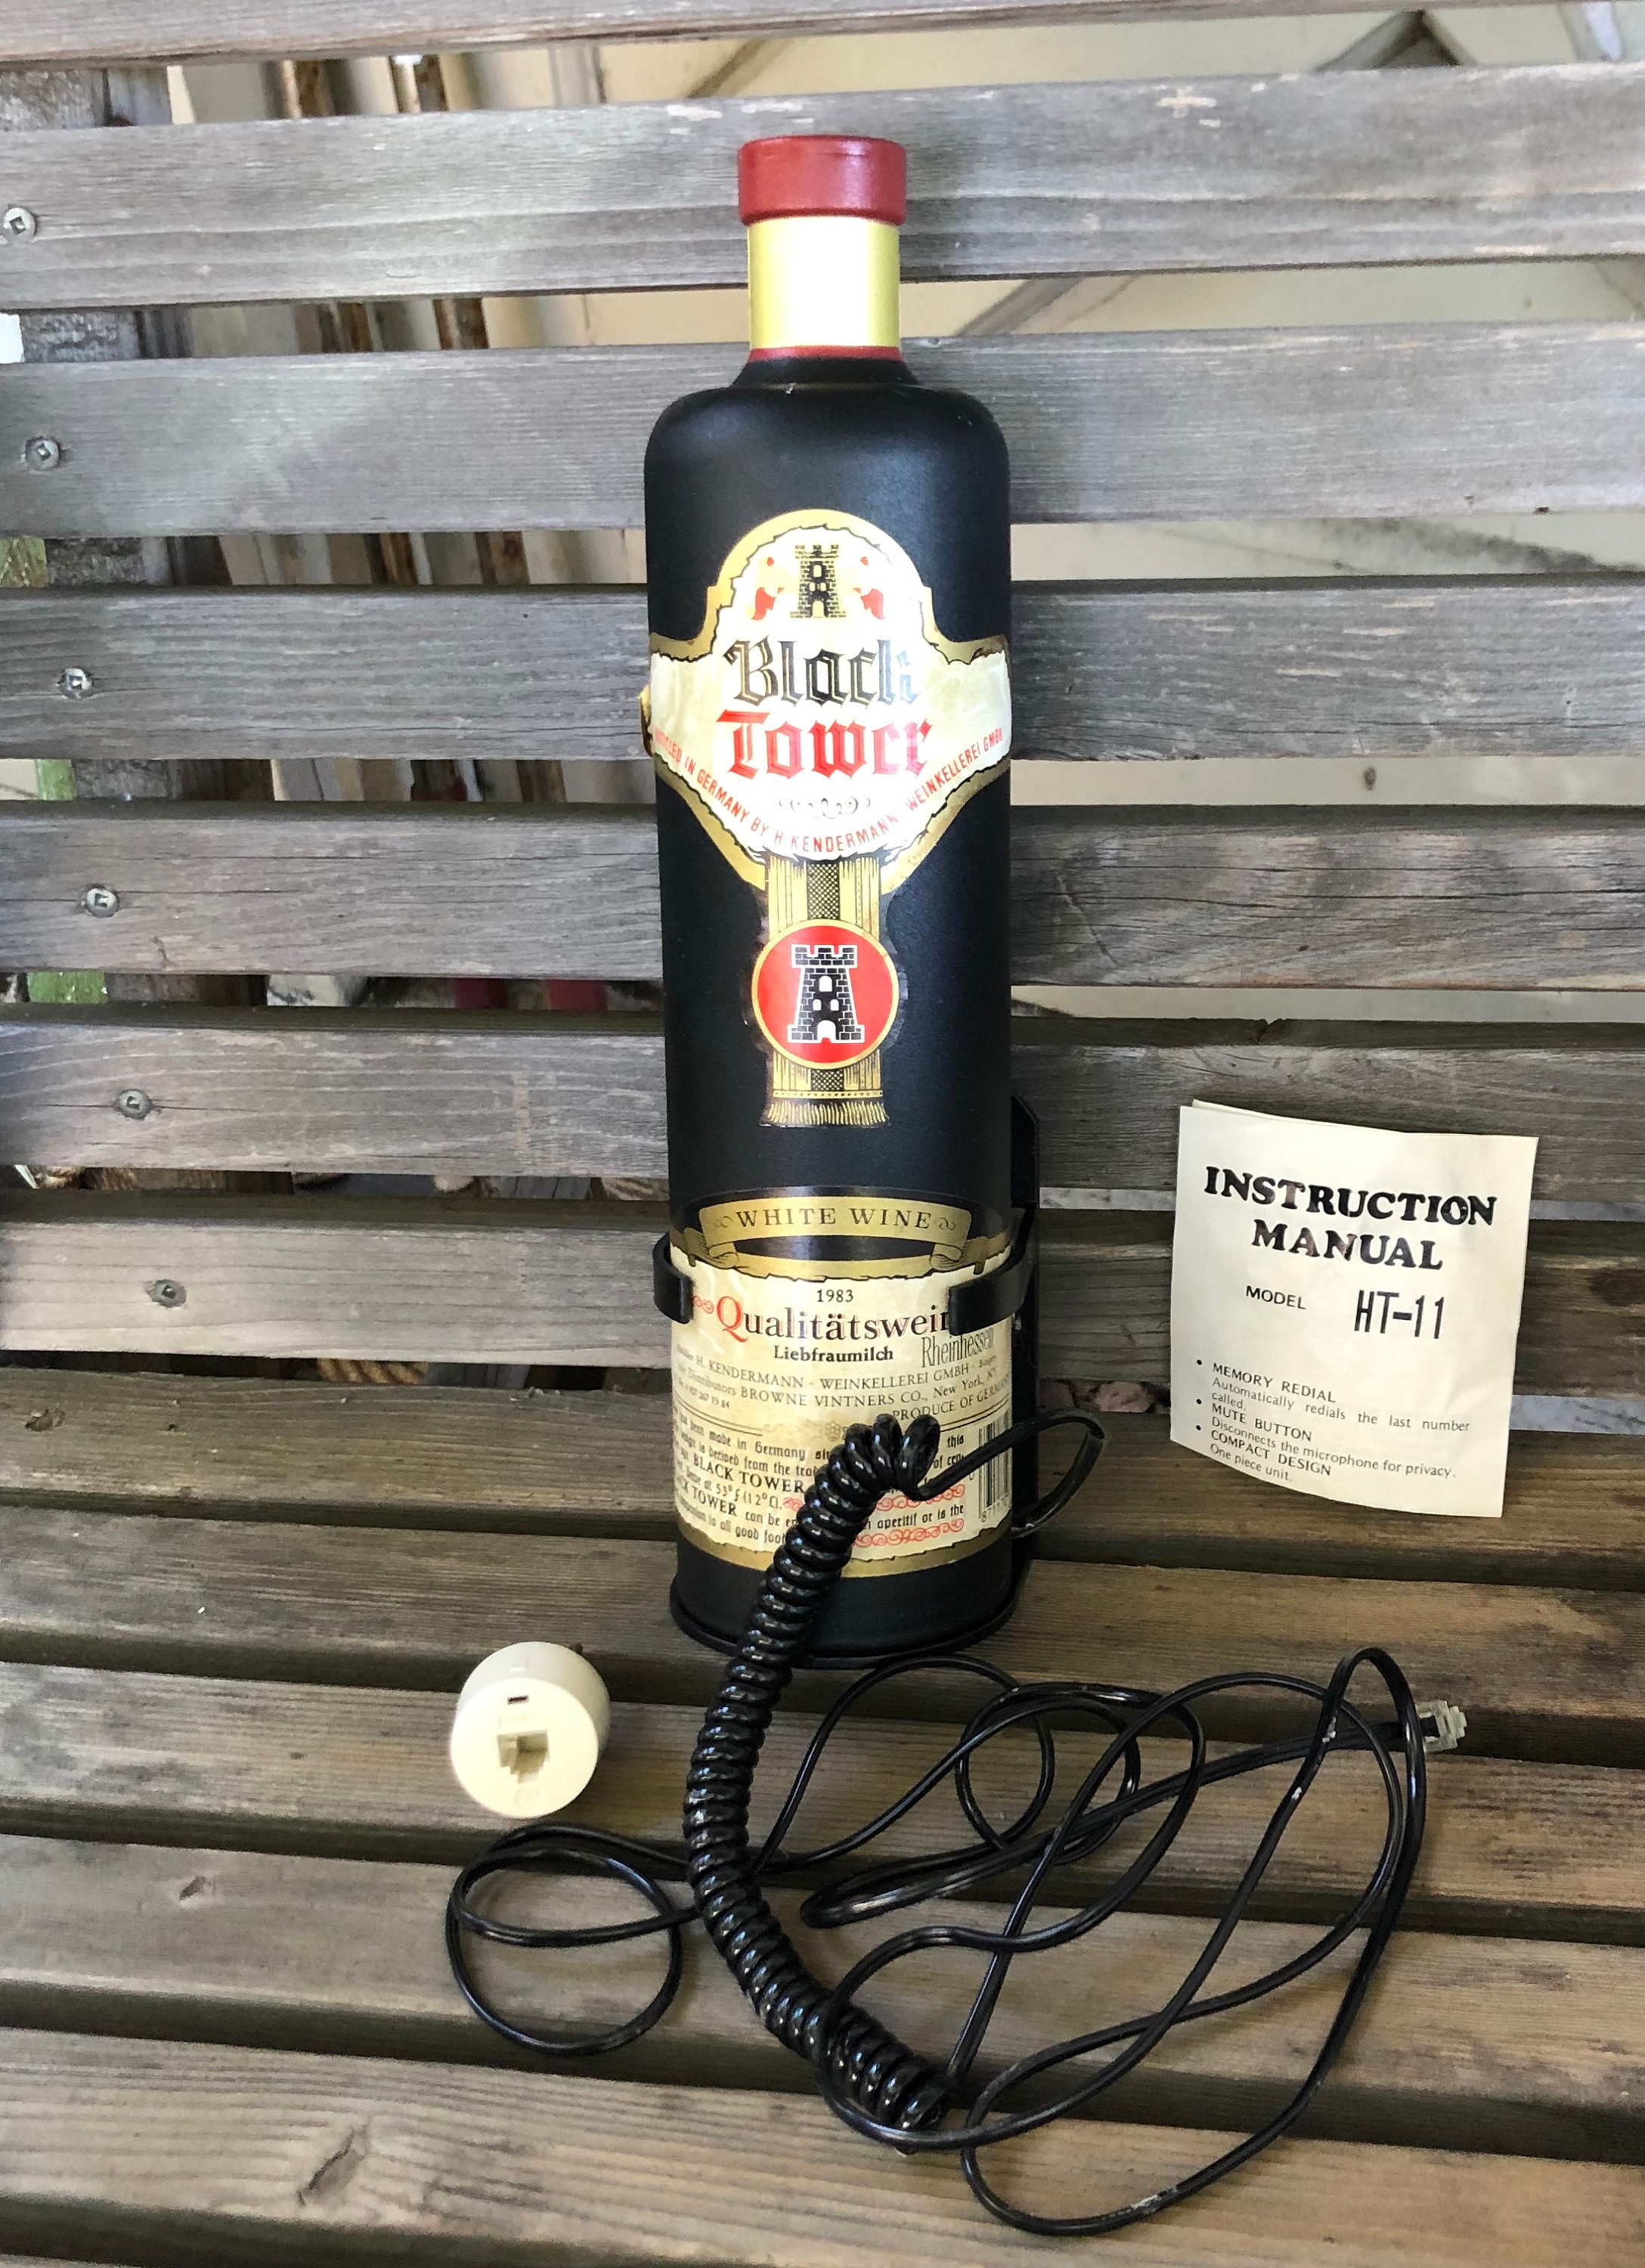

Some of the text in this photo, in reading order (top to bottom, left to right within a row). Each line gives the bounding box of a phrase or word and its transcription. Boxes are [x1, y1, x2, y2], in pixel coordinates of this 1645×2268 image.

[723, 635, 922, 708] Black
[716, 709, 933, 779] Tower
[685, 755, 697, 776] IN
[697, 769, 750, 823] GERMANY
[751, 816, 770, 837] BY
[791, 813, 899, 852] KENDERMANN
[905, 741, 981, 811] WEINKELLEREI
[1204, 1167, 1498, 1225] INSTRUCTION
[736, 1207, 932, 1229] WHITE WINE
[1252, 1219, 1442, 1270] MANUAL
[816, 1288, 854, 1303] 1983
[1246, 1285, 1445, 1340] MODEL HT-11
[773, 1345, 894, 1362] Liebfraumilch
[709, 1360, 805, 1388] KENDERMANN
[820, 1372, 929, 1390] WEINKELLEREI
[934, 1363, 969, 1382] GMBH
[1212, 1362, 1337, 1403] MEMORY REDIAL
[741, 1387, 807, 1406] BROWNE
[815, 1396, 894, 1408] VINTNERS
[933, 1387, 956, 1399] New
[893, 1400, 955, 1421] PRODUCE
[960, 1395, 974, 1408] OF
[1211, 1391, 1247, 1411] called.
[1211, 1377, 1470, 1433] Automatically redials the last number
[947, 1434, 965, 1448] this
[1211, 1402, 1312, 1442] MUTE BUTTON
[737, 1437, 747, 1450] in
[755, 1441, 806, 1461] Germany
[744, 1456, 769, 1472] from
[773, 1461, 791, 1475] the
[934, 1455, 943, 1469] of
[1210, 1442, 1293, 1483] One piece unit.
[1211, 1429, 1332, 1476] COMPACT DESIGN
[1212, 1416, 1457, 1480] Disconnects the microphone for privacy.
[693, 1453, 736, 1482] BLACK
[739, 1470, 805, 1494] TOWER
[692, 1486, 737, 1517] TOWER
[745, 1510, 764, 1523] can
[768, 1513, 780, 1526] be
[922, 1511, 932, 1523] or
[937, 1508, 945, 1520] is
[950, 1504, 964, 1517] the
